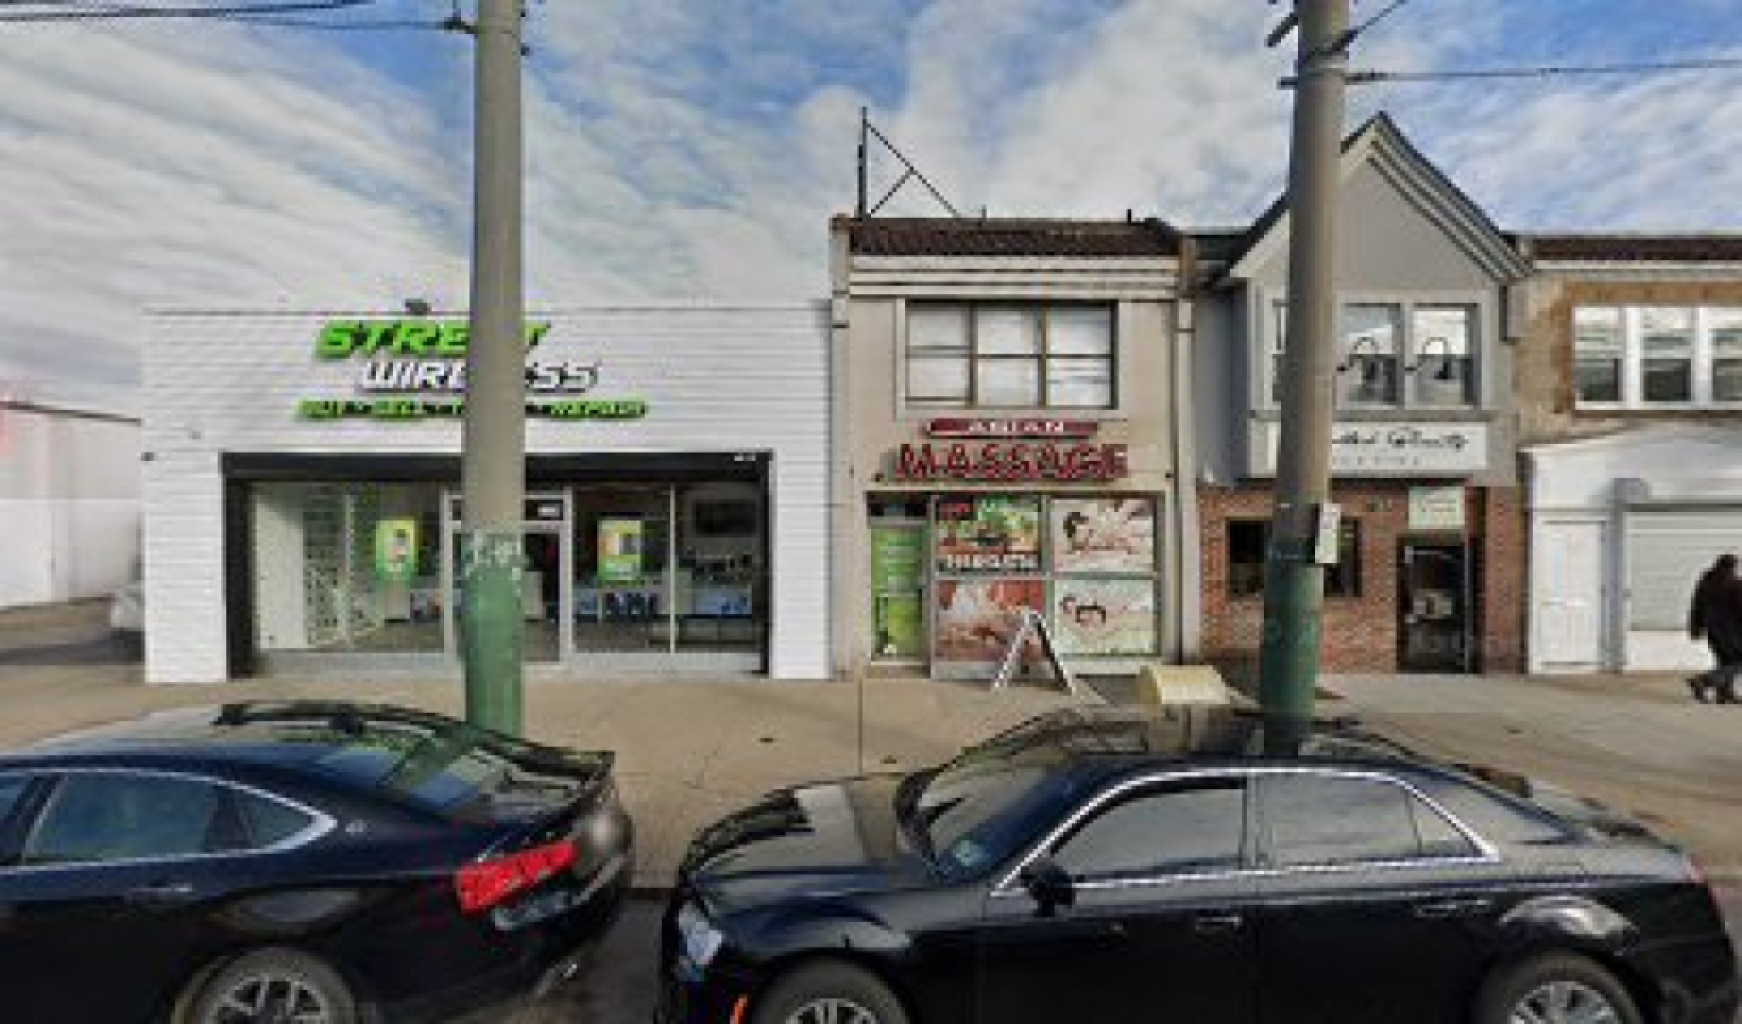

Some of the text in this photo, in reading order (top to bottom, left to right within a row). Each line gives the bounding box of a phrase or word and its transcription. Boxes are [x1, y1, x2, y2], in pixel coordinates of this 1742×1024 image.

[314, 320, 551, 360] STRET
[359, 361, 601, 393] WIRESS
[895, 443, 1129, 480] MASSAGE
